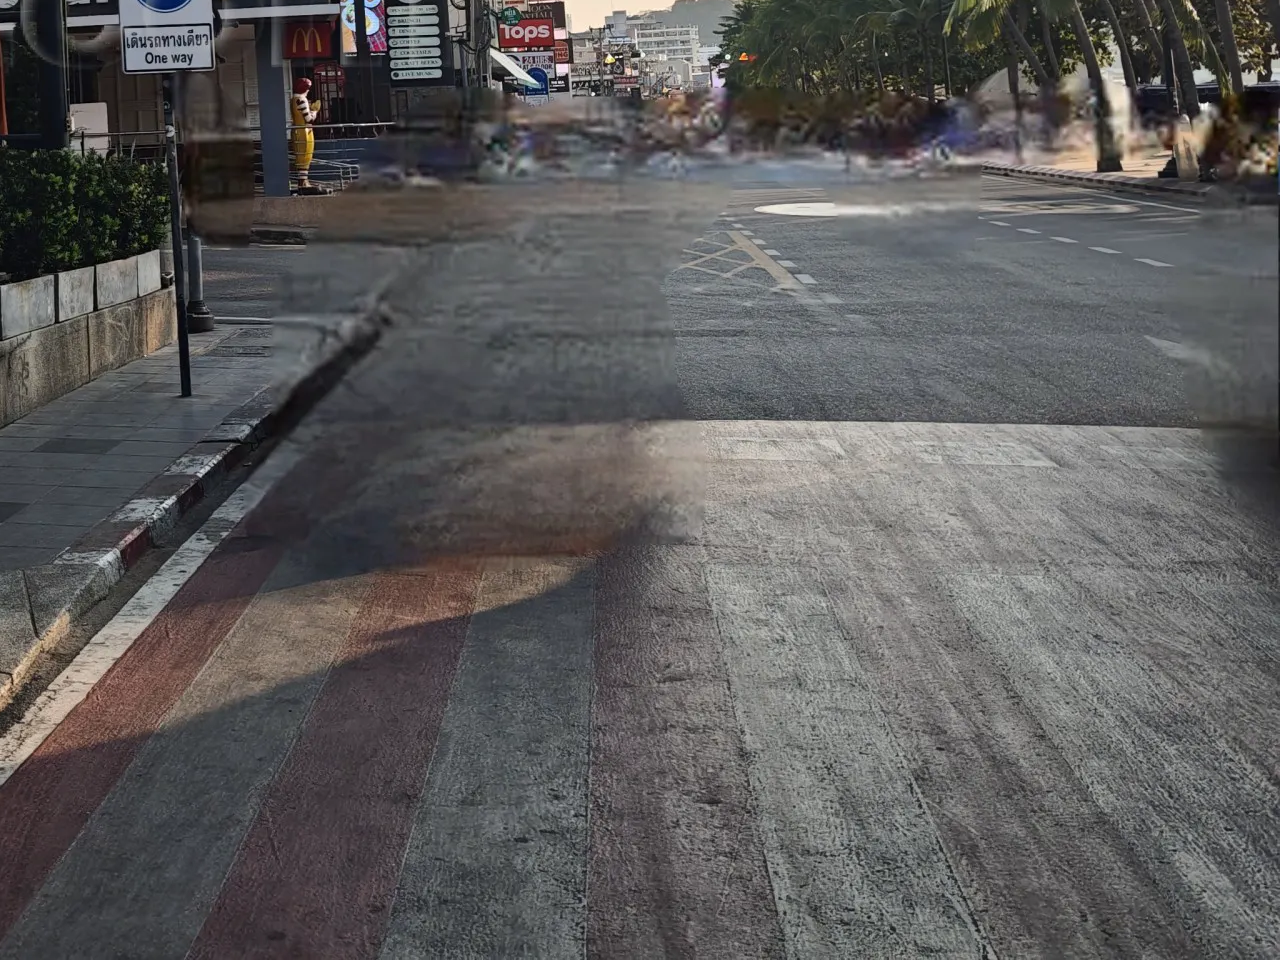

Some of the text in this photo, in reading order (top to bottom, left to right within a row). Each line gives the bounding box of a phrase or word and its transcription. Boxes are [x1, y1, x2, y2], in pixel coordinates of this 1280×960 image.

[126, 28, 209, 49] เดินรถทางเดียว
[500, 24, 551, 42] Tops
[145, 52, 194, 66] One way
